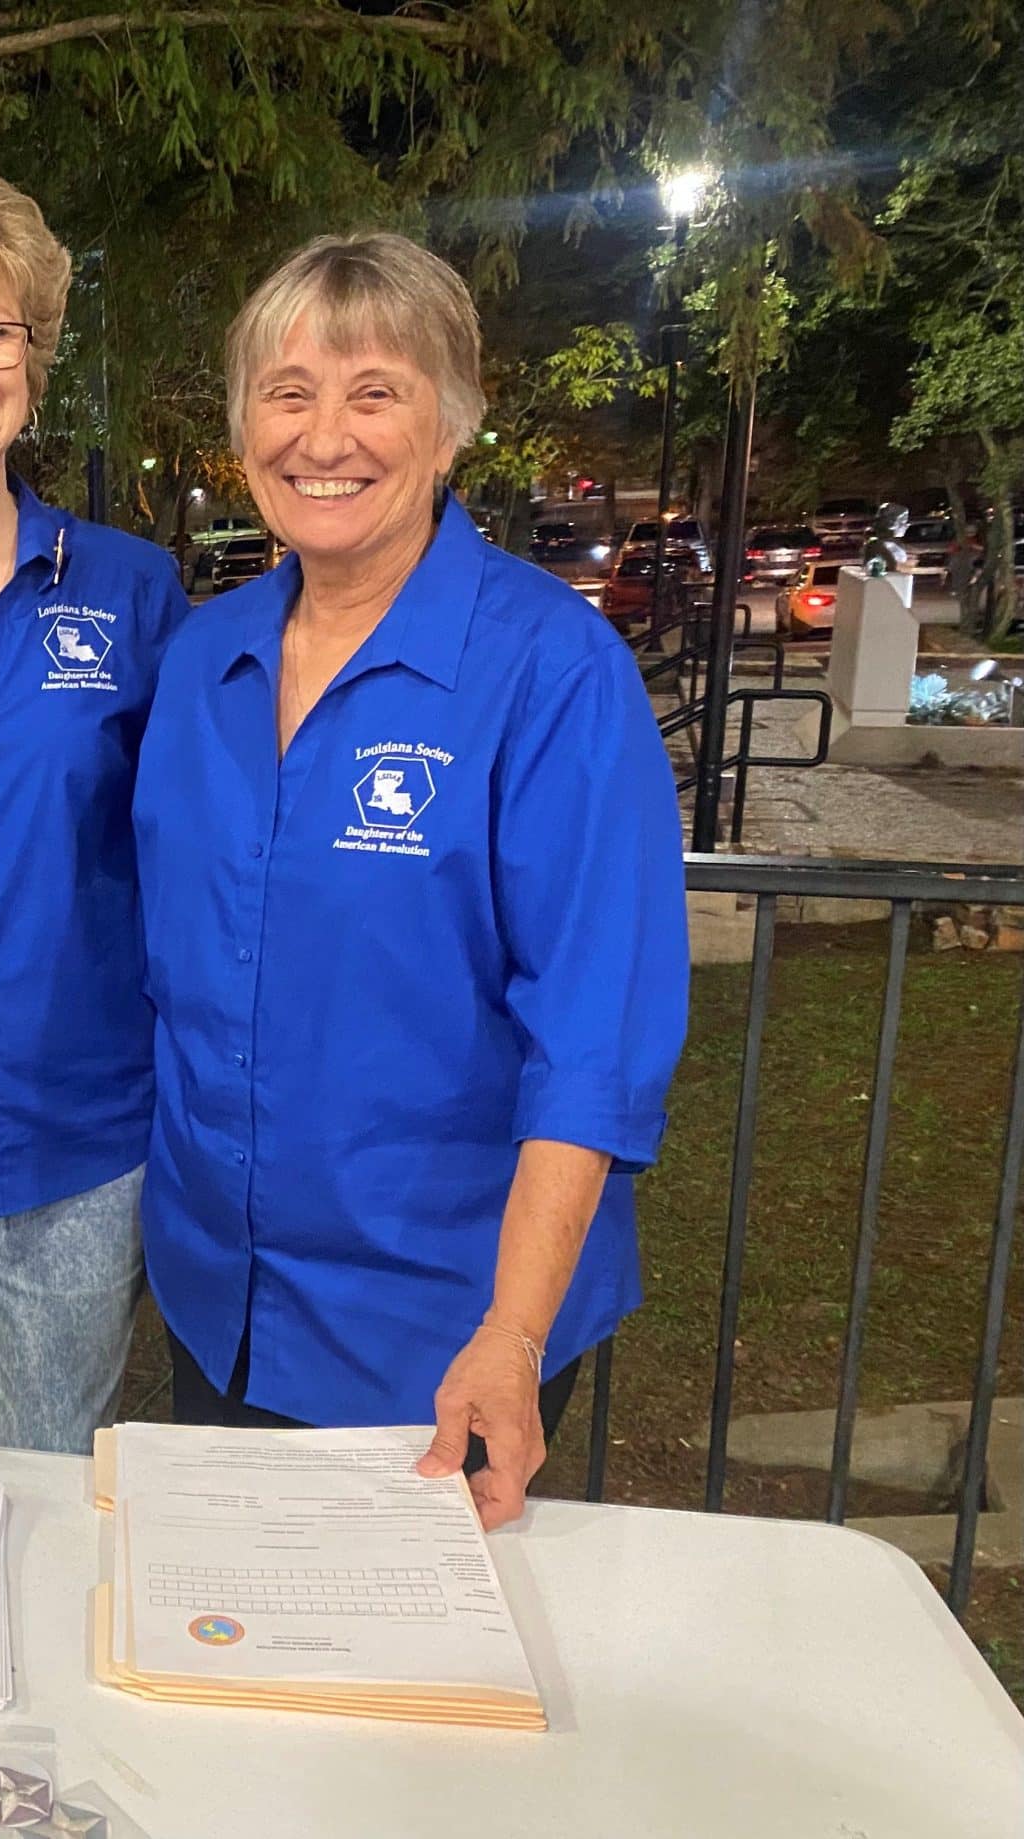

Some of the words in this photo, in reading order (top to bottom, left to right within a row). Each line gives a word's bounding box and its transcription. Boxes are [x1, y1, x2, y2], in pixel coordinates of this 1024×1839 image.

[38, 604, 80, 618] Louisiana
[82, 606, 116, 623] Society
[48, 672, 88, 680] Daughters
[90, 671, 98, 679] of
[99, 671, 111, 679] the
[41, 681, 79, 690] American
[355, 742, 413, 760] Louisiana
[414, 743, 455, 766] Society
[345, 825, 394, 840] Daughters
[395, 830, 407, 840] of
[407, 830, 423, 842] the
[333, 838, 377, 852] American
[378, 842, 430, 856] Revolution
